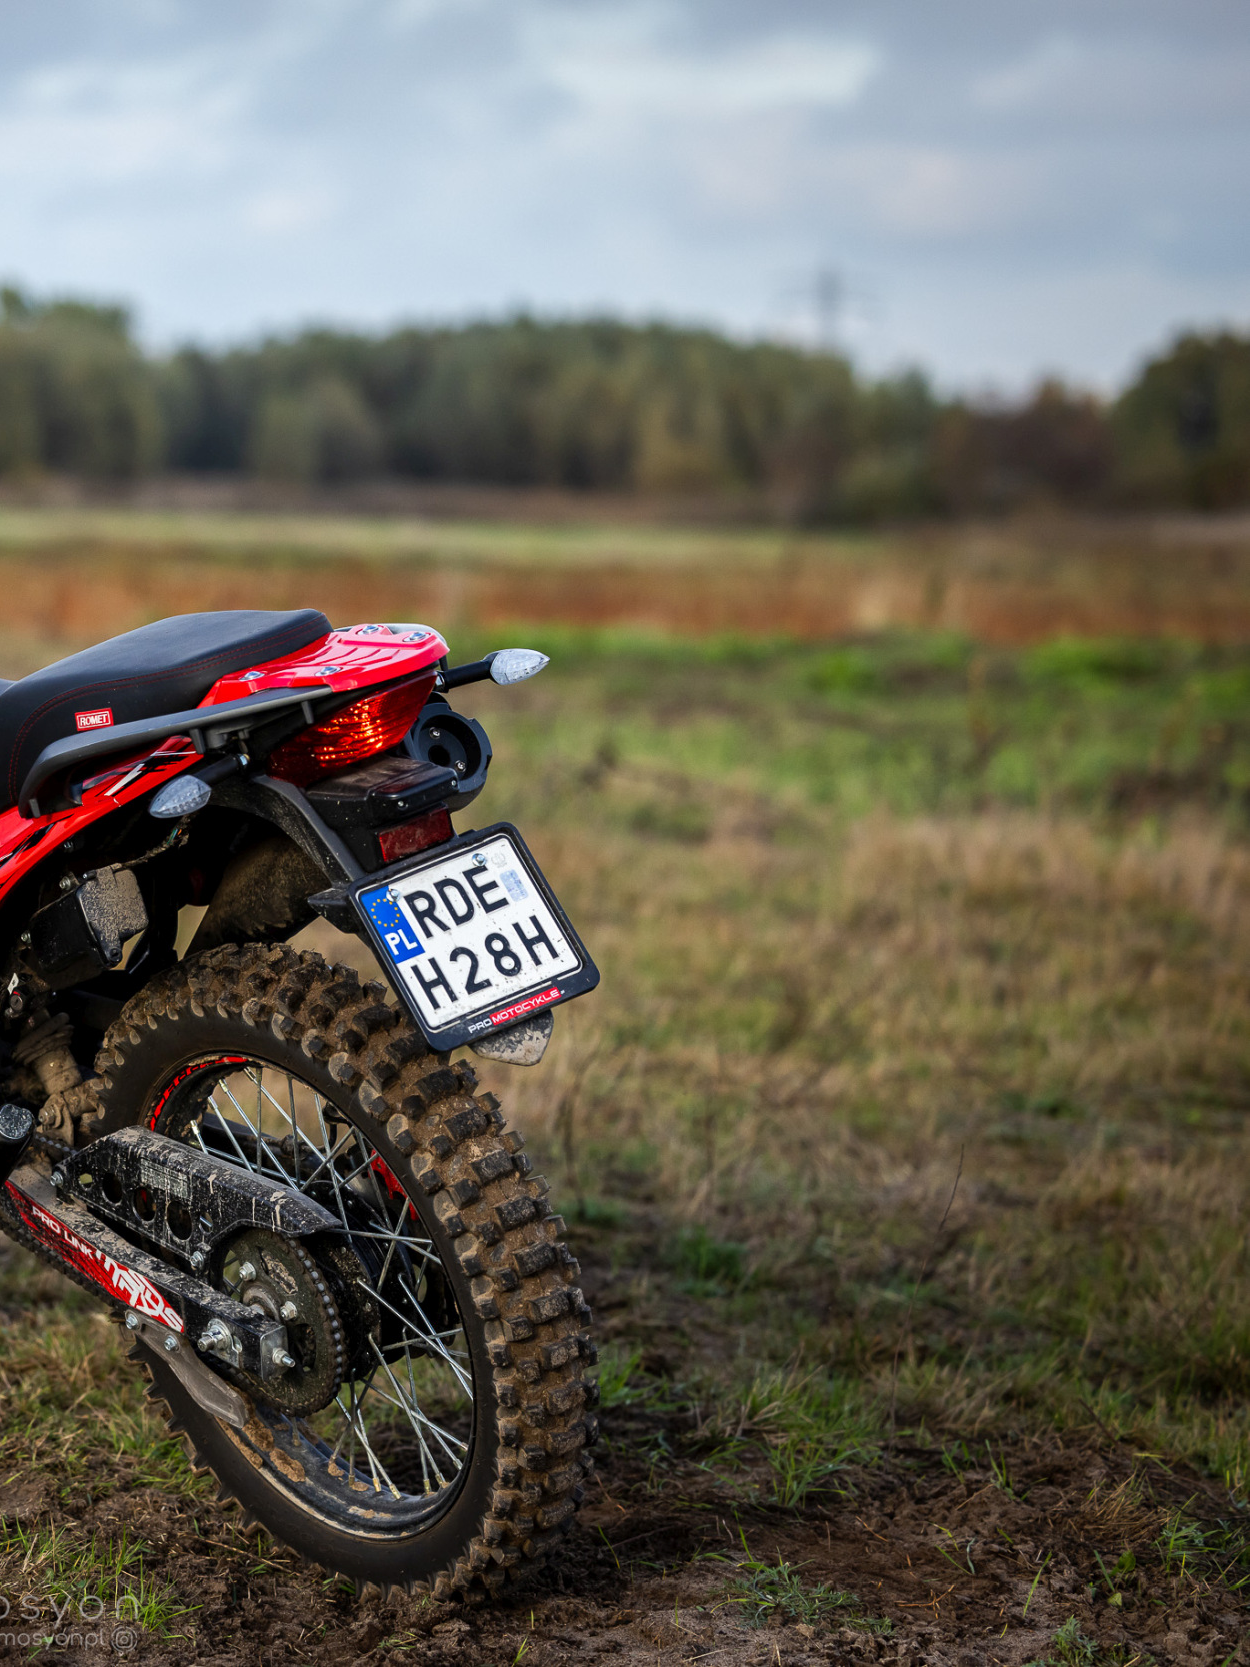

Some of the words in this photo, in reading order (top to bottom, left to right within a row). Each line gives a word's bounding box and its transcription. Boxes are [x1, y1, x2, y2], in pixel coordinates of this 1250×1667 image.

[80, 714, 108, 726] ROMET
[403, 865, 509, 939] RDE
[384, 928, 418, 956] PL
[411, 915, 559, 1010] H28H
[32, 1206, 61, 1236] PRO
[64, 1230, 94, 1260] LINK
